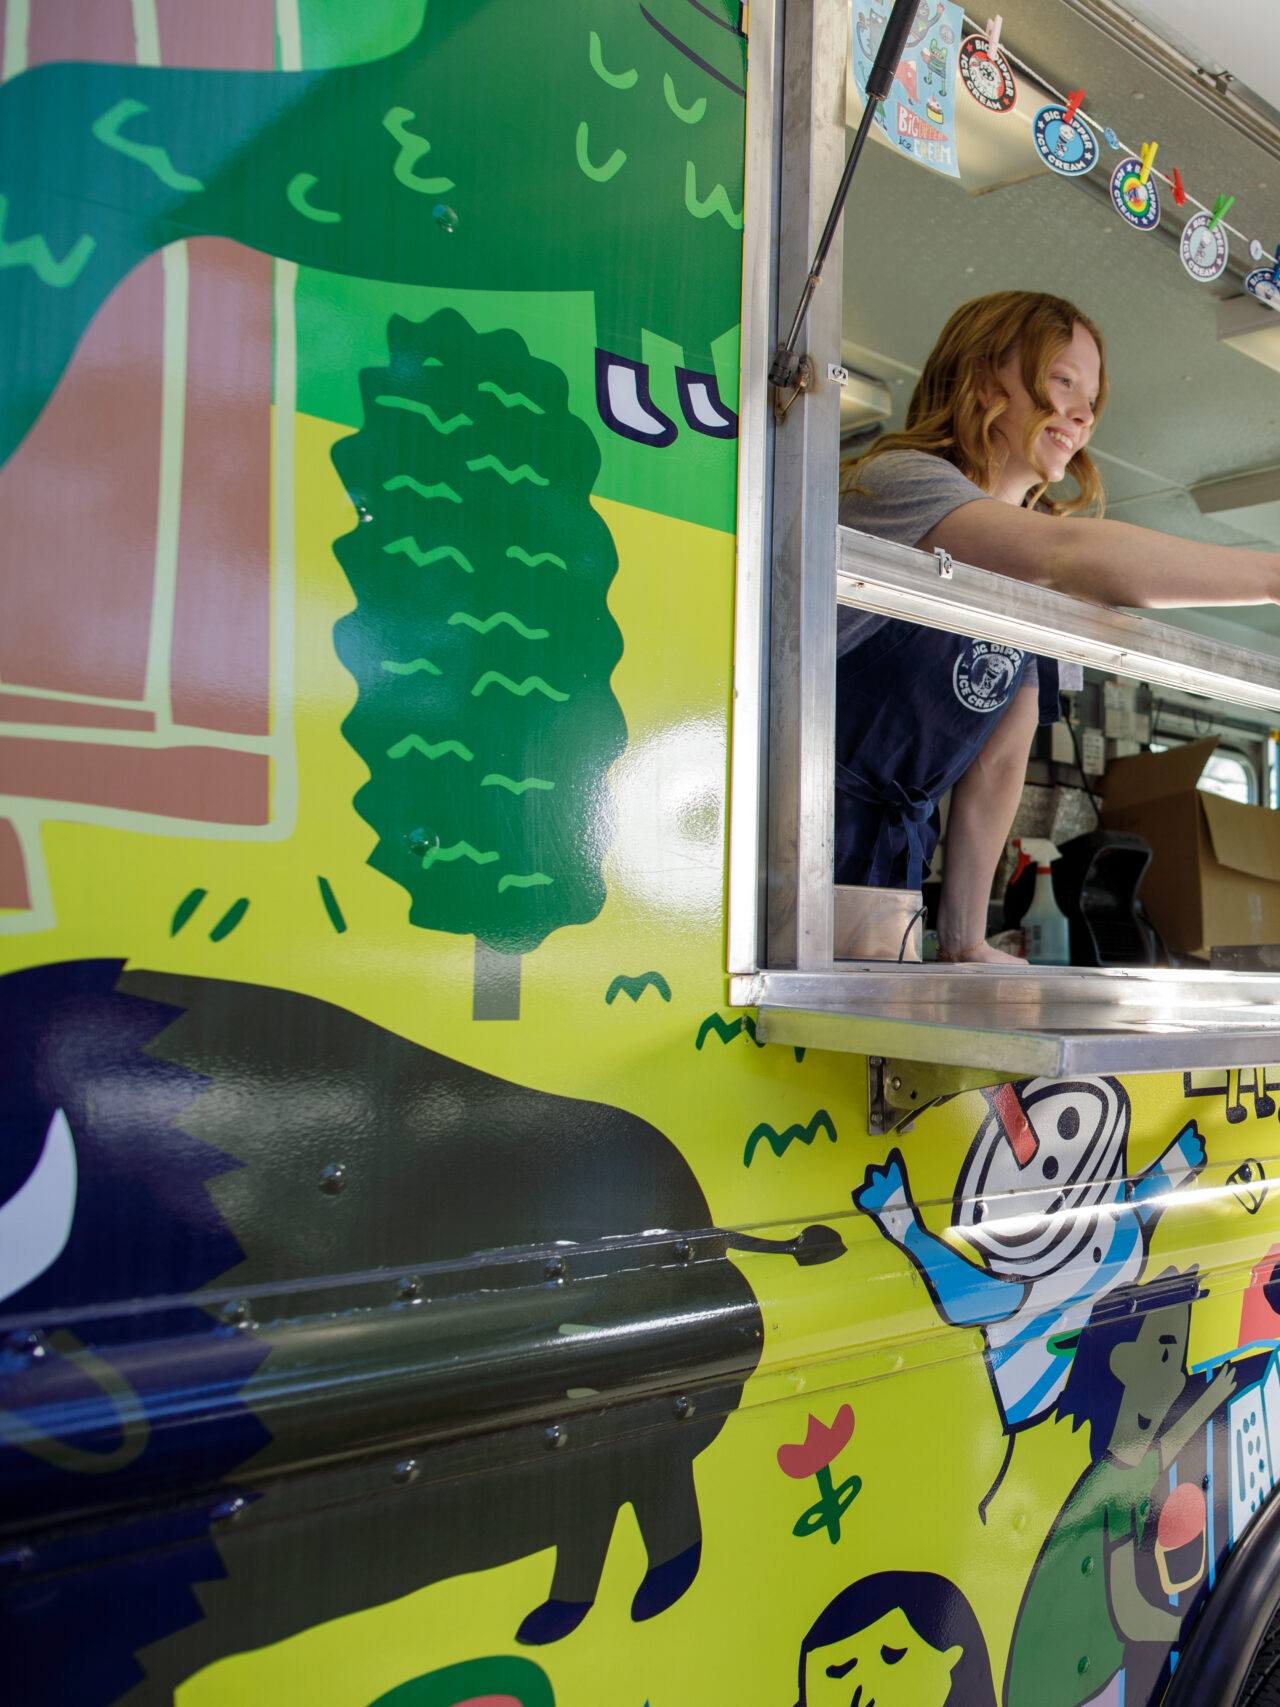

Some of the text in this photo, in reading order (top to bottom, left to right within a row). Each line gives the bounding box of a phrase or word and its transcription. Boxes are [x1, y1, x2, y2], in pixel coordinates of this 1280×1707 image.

[960, 53, 1003, 111] ICE CREAM
[1043, 111, 1061, 122] BIG
[913, 139, 953, 166] CREAM
[1036, 133, 1087, 172] ICE CREAM
[1114, 168, 1126, 188] ICE
[1113, 189, 1139, 225] CREAM
[1192, 217, 1206, 229] BIG
[1183, 240, 1217, 277] ICE CREAM
[959, 674, 972, 696] ICE
